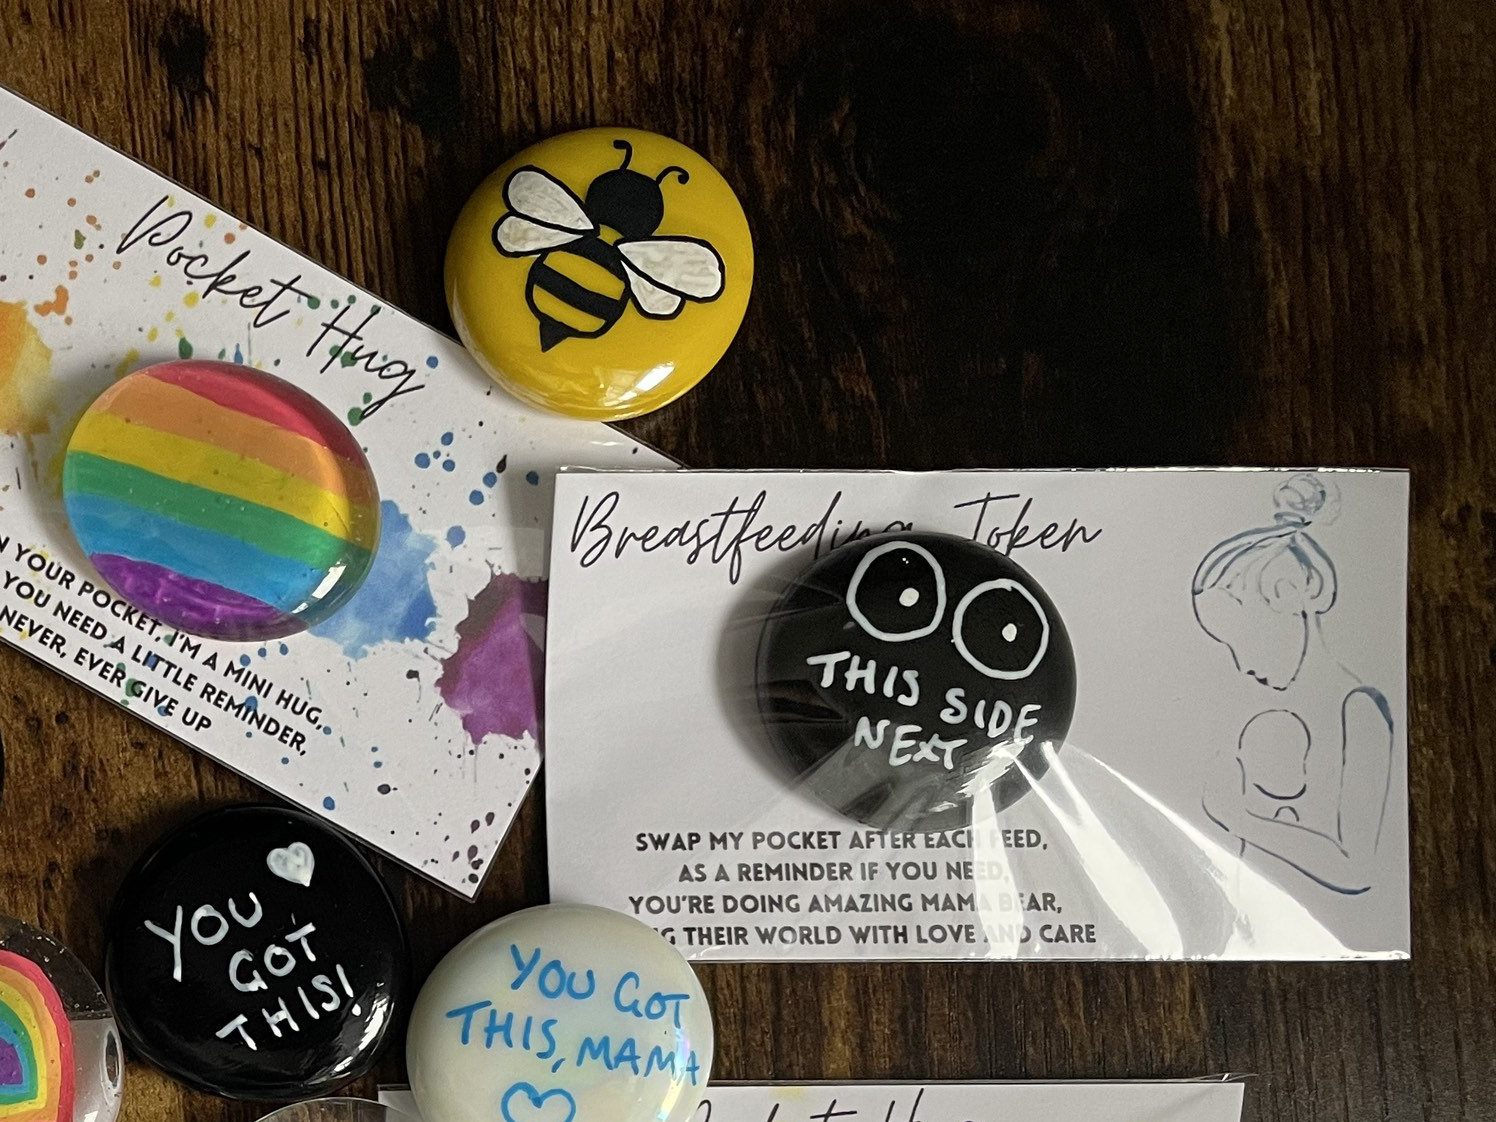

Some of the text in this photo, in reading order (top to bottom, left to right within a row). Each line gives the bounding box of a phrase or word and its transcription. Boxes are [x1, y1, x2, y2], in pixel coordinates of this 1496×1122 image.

[116, 195, 425, 418] Pocket Hug
[954, 492, 1102, 557] Token
[14, 542, 75, 590] YOUR
[77, 580, 162, 642] POCKET,
[167, 628, 201, 659] I'M
[201, 651, 217, 671] A
[222, 660, 273, 698] MINI
[275, 688, 322, 730] HUG,
[807, 650, 1042, 743] THIS SIDE
[854, 716, 967, 770] NEXT
[635, 828, 916, 851] SWAP MY POCKET AFTER
[678, 861, 937, 882] AS A REMINDER IF YOU
[145, 892, 262, 982] YOU
[628, 893, 913, 914] YOU'RE DOING AMAZING
[682, 926, 748, 946] THEIR
[754, 925, 841, 945] WORLD
[848, 924, 908, 944] WITH
[915, 923, 976, 943] LOVE
[1038, 923, 1096, 943] CARE
[228, 914, 315, 991] GOT
[510, 944, 690, 1030] YOU GOT
[216, 964, 362, 1050] THIS!
[446, 1000, 700, 1087] THIS, MAMA
